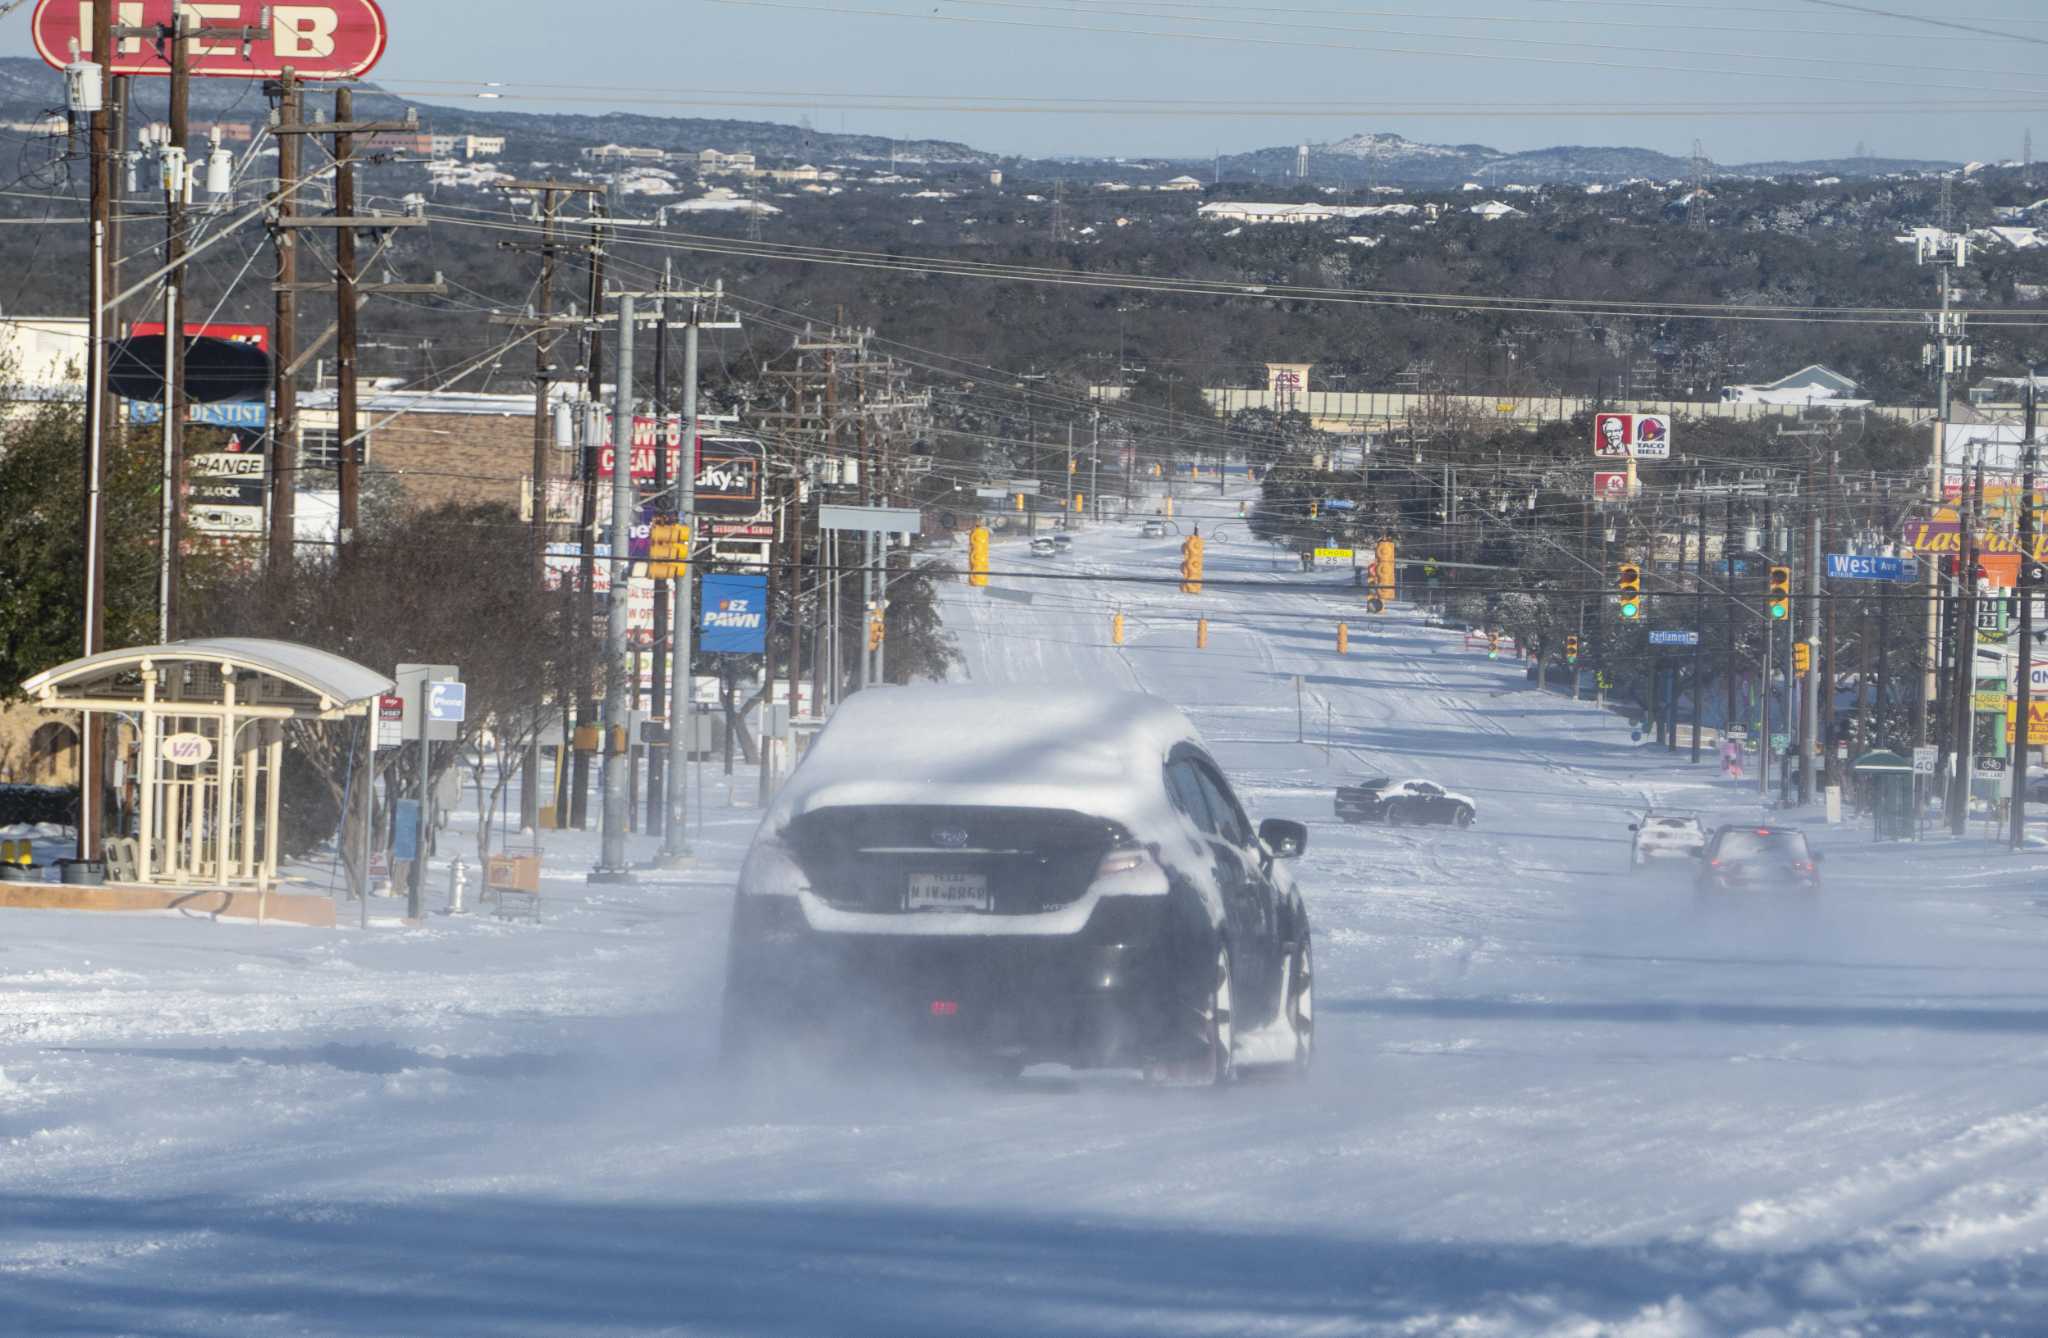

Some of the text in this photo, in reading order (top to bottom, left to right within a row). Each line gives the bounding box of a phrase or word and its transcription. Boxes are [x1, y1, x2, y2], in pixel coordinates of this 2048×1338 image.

[1276, 373, 1300, 384] CVS
[190, 404, 262, 423] DENTIST
[1834, 556, 1877, 573] West
[728, 600, 749, 612] EZ
[704, 612, 761, 628] PAWN
[435, 698, 462, 707] Phone
[1915, 761, 1934, 771] 40
